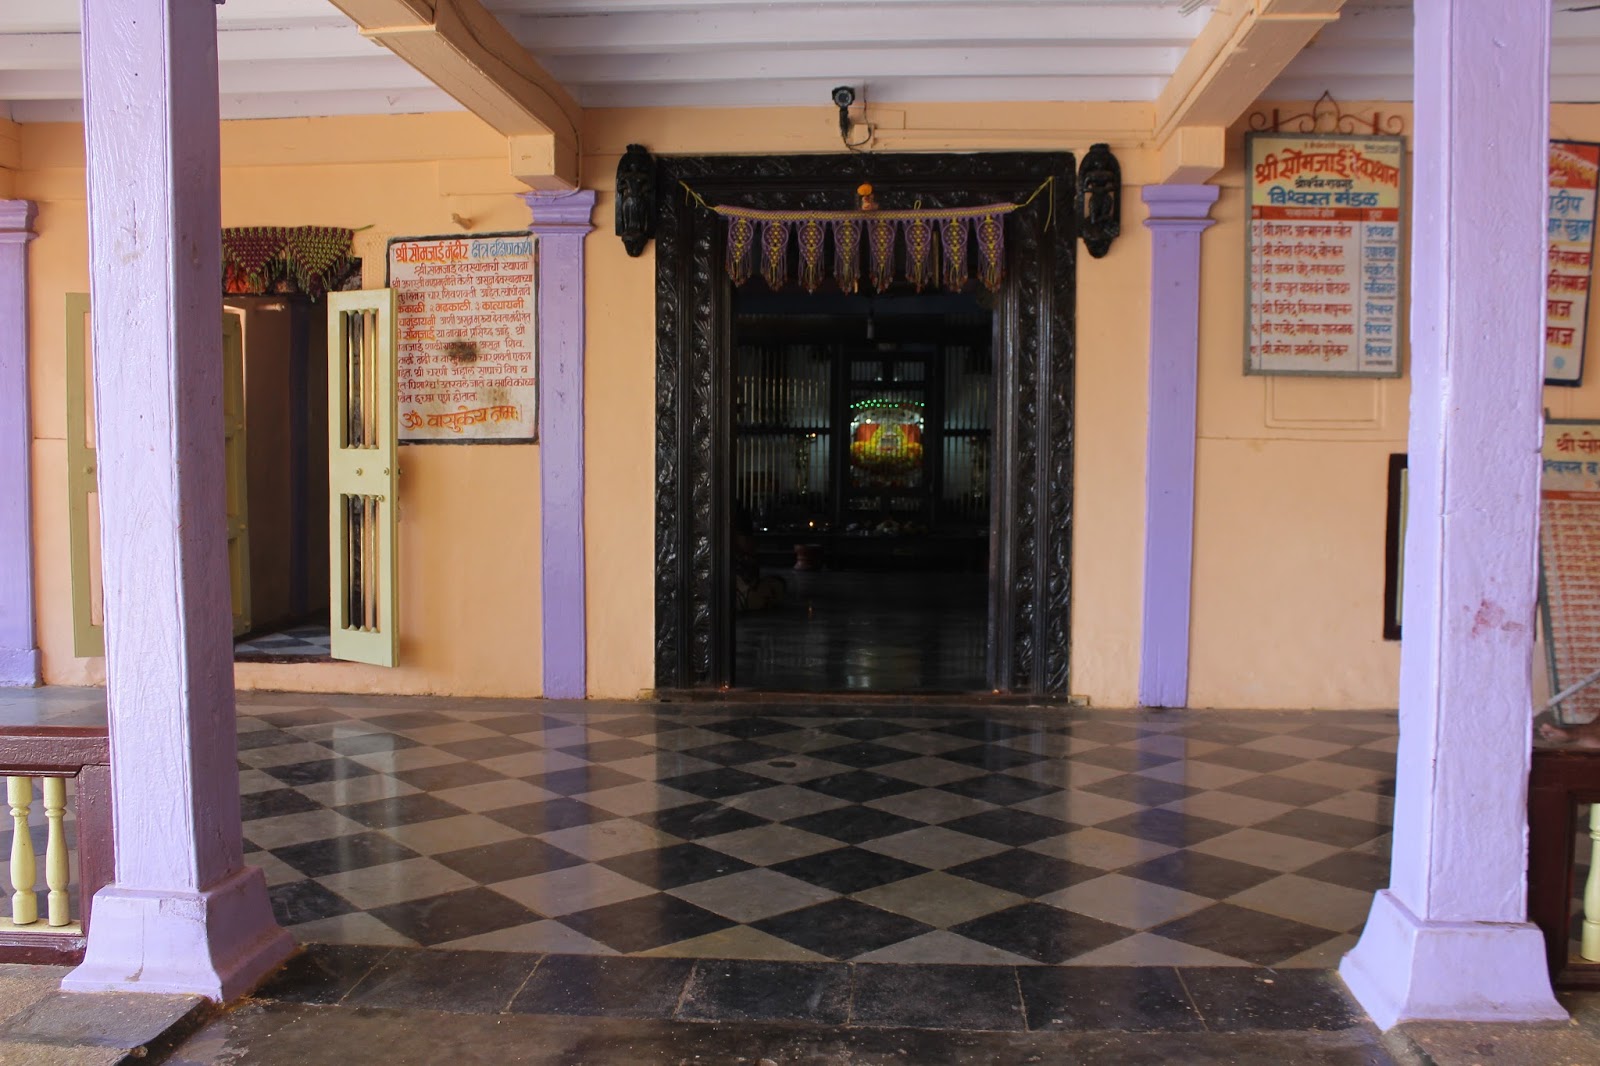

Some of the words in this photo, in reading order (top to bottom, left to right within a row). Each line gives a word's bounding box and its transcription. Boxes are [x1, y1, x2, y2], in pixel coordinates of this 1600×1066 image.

[1255, 153, 1278, 184] श्री
[1268, 185, 1331, 206] विश्वस्त
[1334, 189, 1379, 207] मंडळ
[396, 243, 408, 262] श्री
[408, 241, 444, 263] सोमजाई
[445, 240, 469, 260] मंदीर
[414, 263, 427, 276] श्री
[501, 261, 528, 271] स्थापना
[482, 297, 525, 311] कात्यायनी
[436, 329, 444, 338] या
[515, 324, 525, 336] श्री
[398, 340, 424, 352] मजाई
[413, 366, 424, 377] श्री
[1557, 433, 1575, 453] श्री
